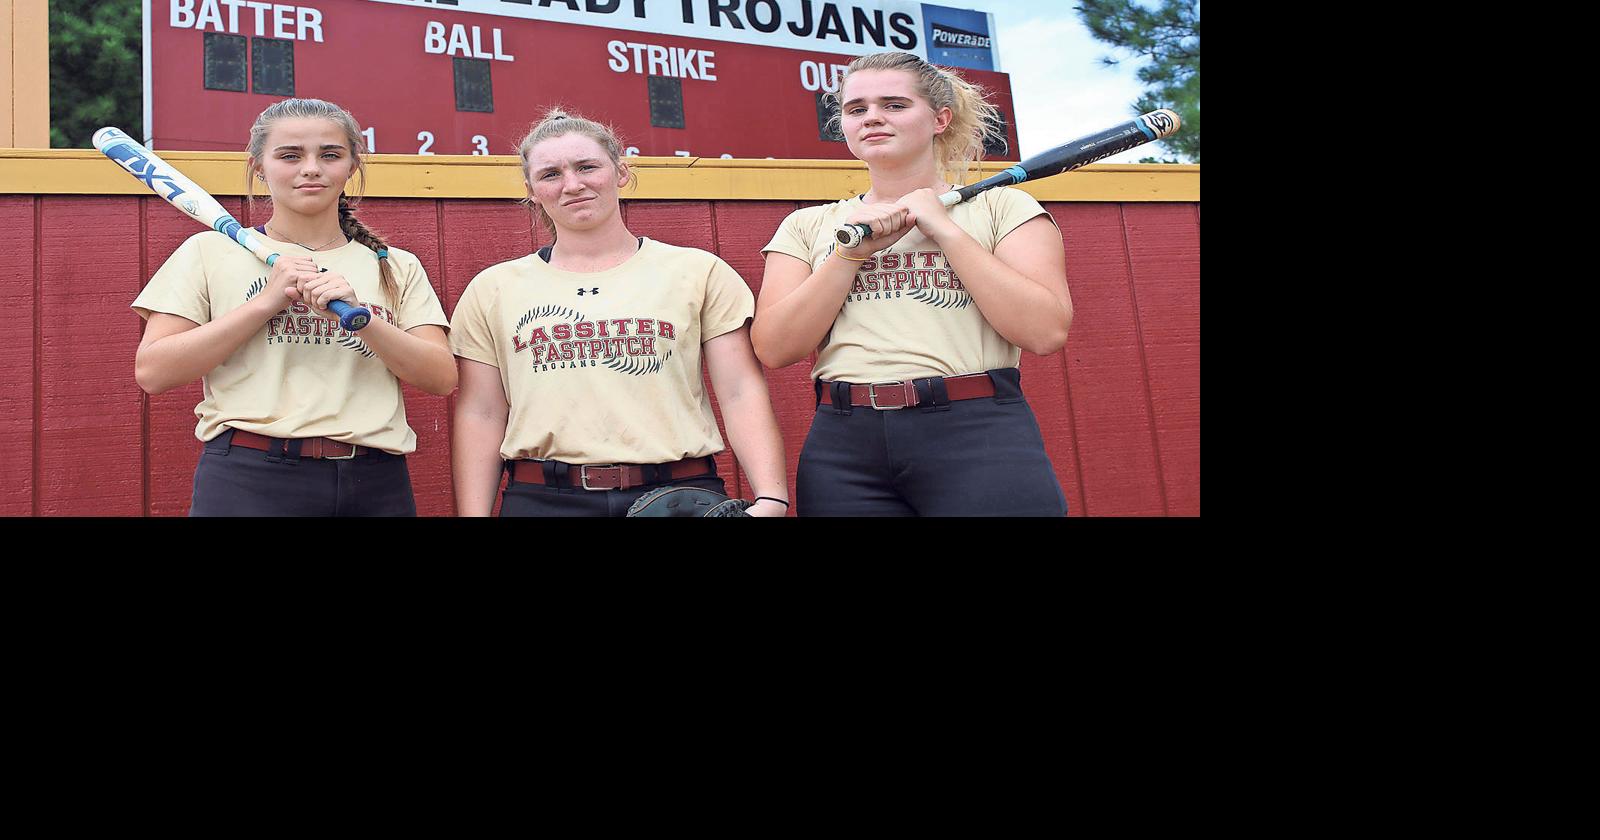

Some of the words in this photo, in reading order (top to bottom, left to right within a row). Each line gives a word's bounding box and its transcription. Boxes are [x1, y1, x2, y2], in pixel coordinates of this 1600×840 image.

[169, 0, 324, 42] BATTER
[678, 0, 918, 50] TROJANS
[424, 21, 514, 61] BALL
[607, 40, 717, 81] STRIKE
[361, 127, 376, 154] 1
[417, 130, 435, 156] 2
[471, 134, 489, 156] 3
[267, 336, 331, 345] TROJANS
[511, 318, 676, 353] LASSITER
[531, 337, 657, 366] FASTPITCH
[533, 359, 596, 373] TROJANS
